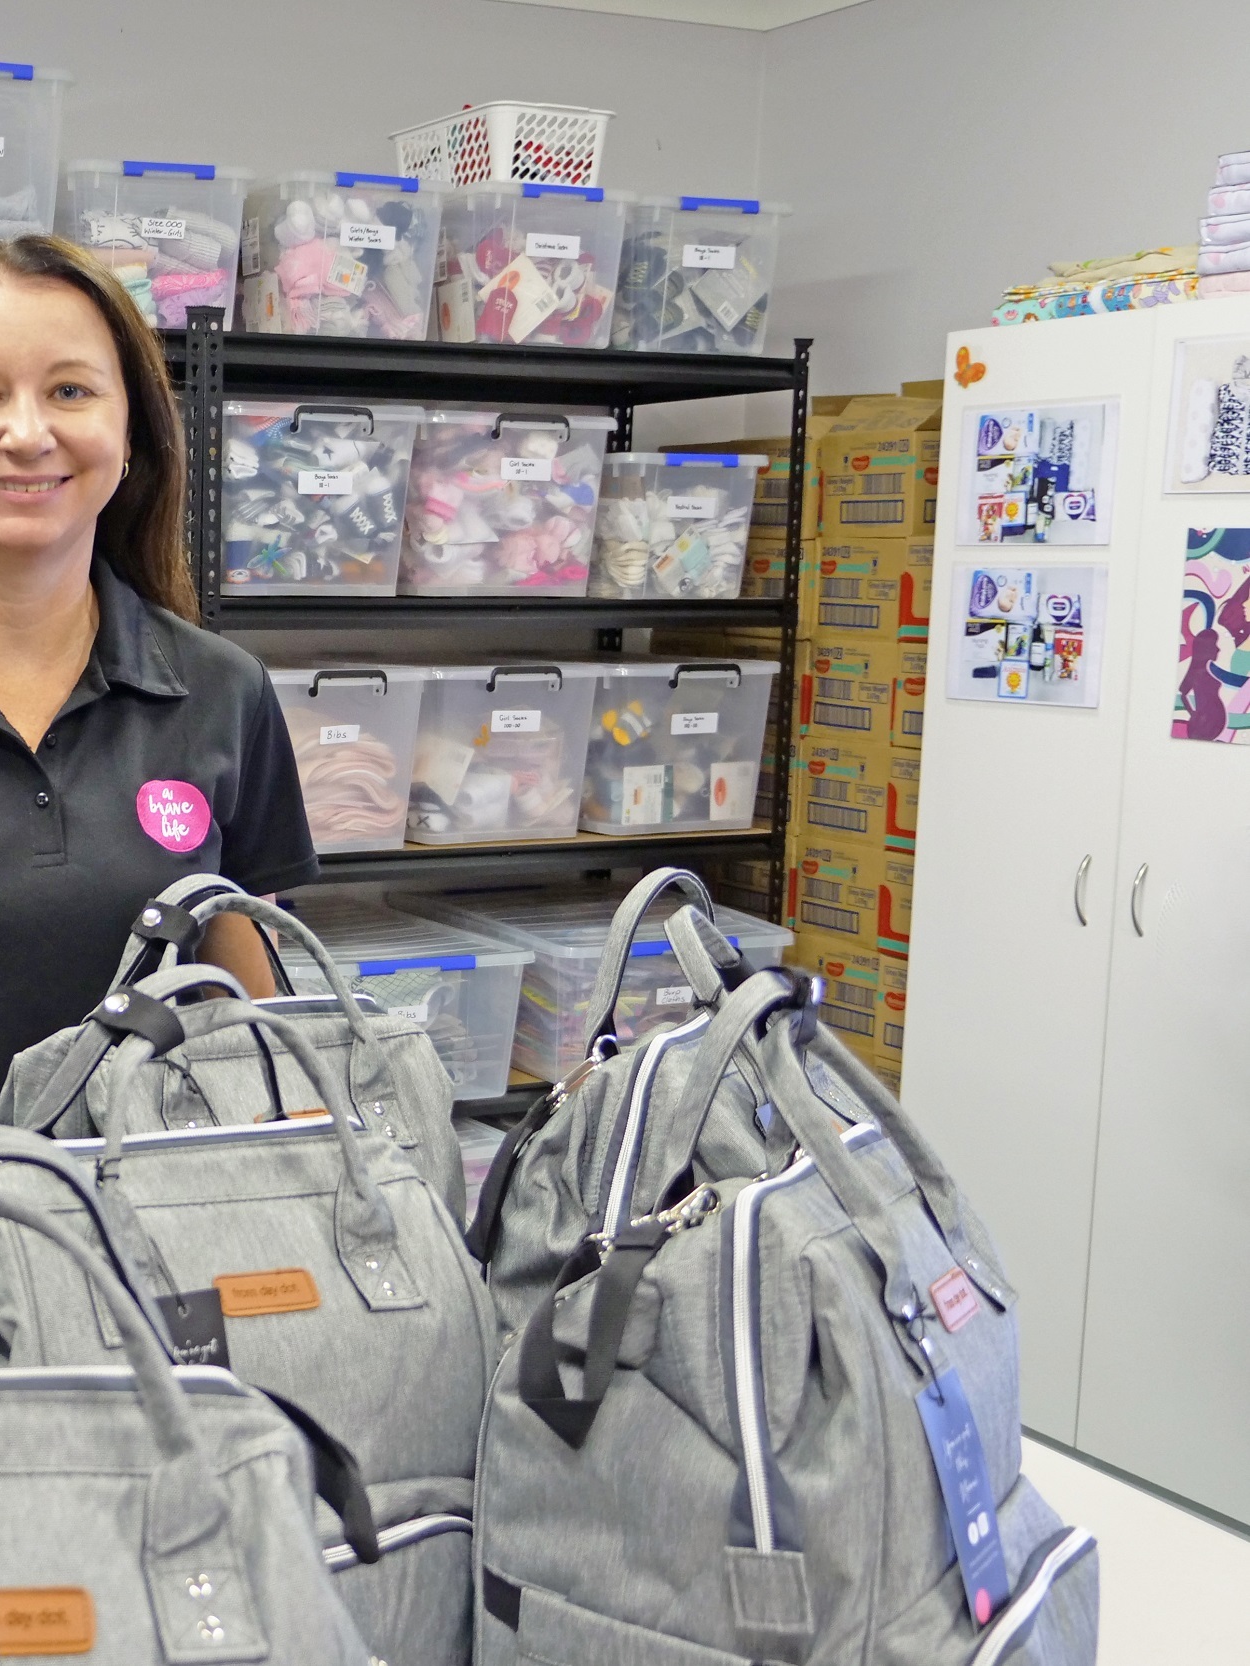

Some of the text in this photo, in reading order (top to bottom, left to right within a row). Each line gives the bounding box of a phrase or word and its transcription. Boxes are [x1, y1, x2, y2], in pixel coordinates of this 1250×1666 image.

[147, 219, 164, 227] Size
[314, 473, 326, 481] Boys
[499, 714, 510, 722] Girl
[326, 729, 347, 740] Bibs
[161, 787, 173, 801] a
[148, 795, 194, 816] brave
[161, 815, 190, 842] life
[663, 988, 681, 996] Burp
[231, 1286, 258, 1298] from
[259, 1284, 278, 1297] day
[3, 1611, 33, 1629] day
